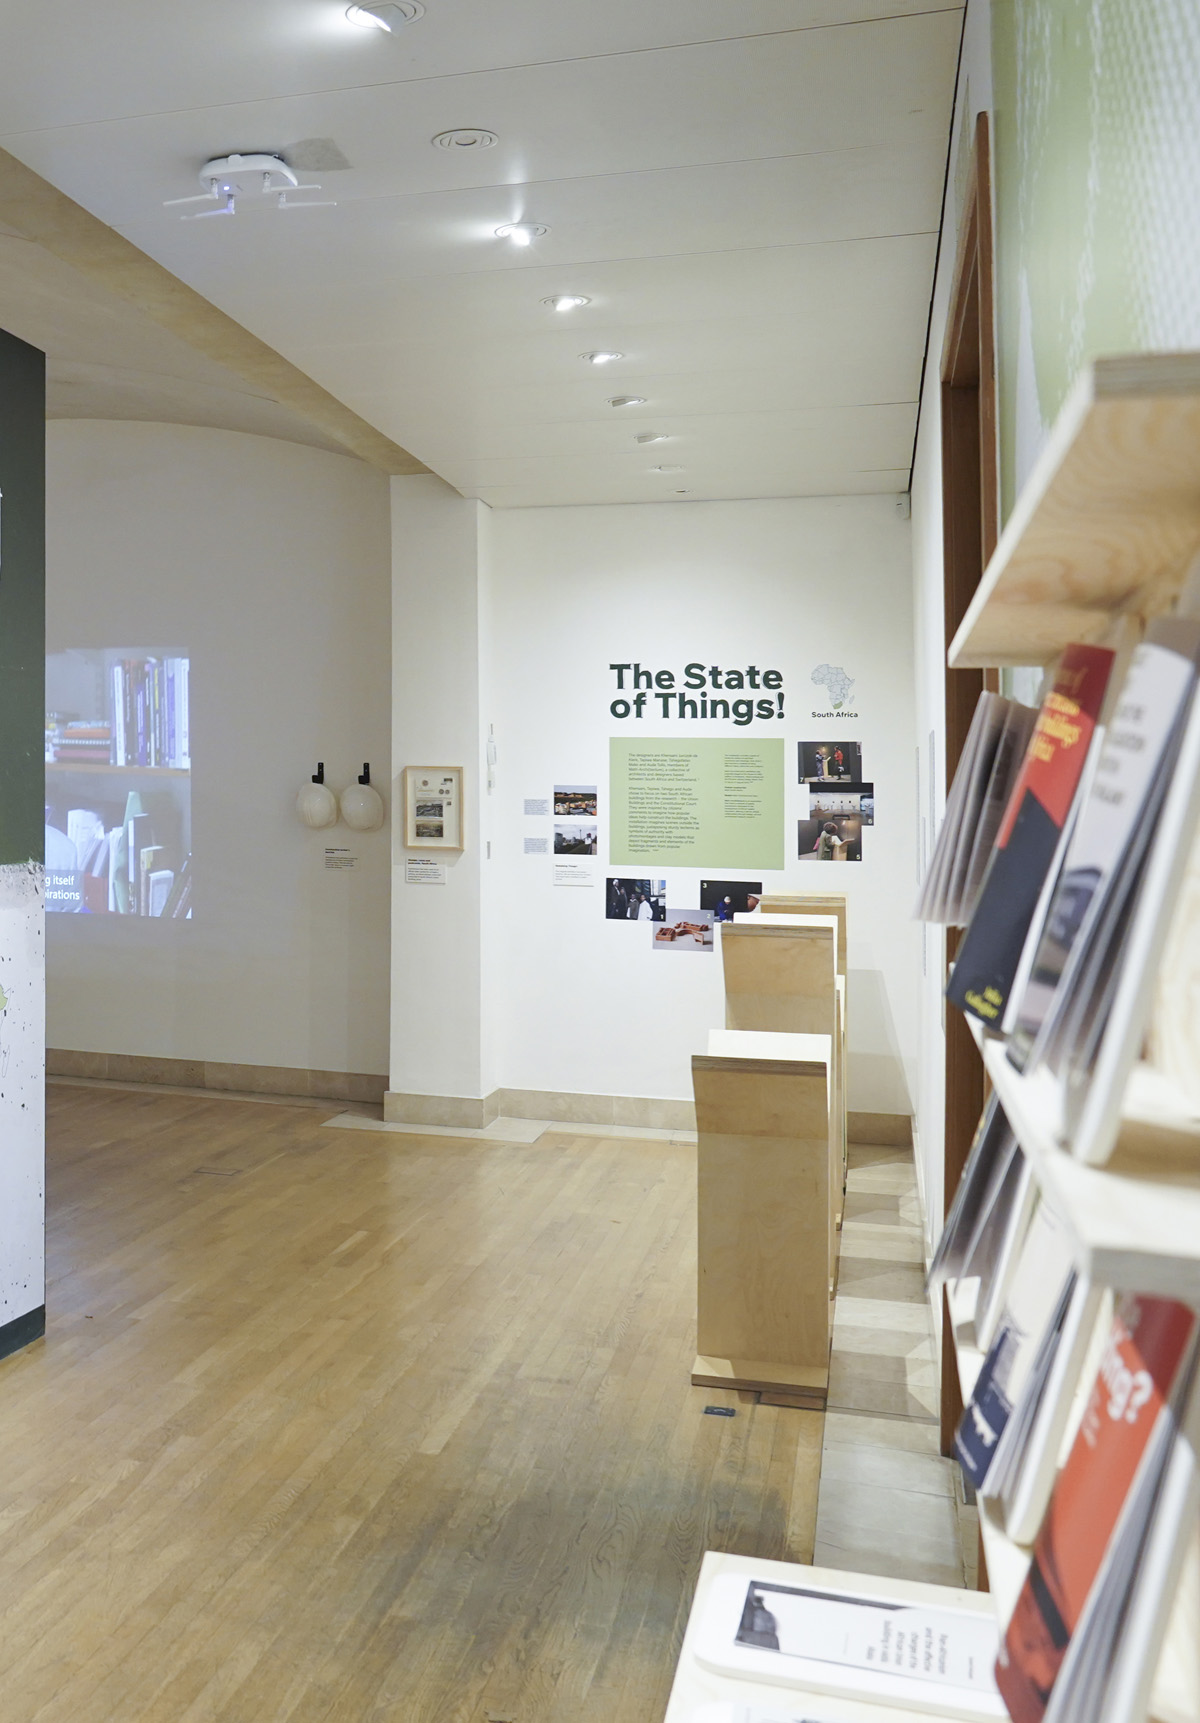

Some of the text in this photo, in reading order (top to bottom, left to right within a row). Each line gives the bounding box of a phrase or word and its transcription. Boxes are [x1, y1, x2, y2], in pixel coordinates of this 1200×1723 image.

[609, 662, 784, 690] The State
[610, 692, 785, 726] of Things!
[53, 875, 74, 885] itself
